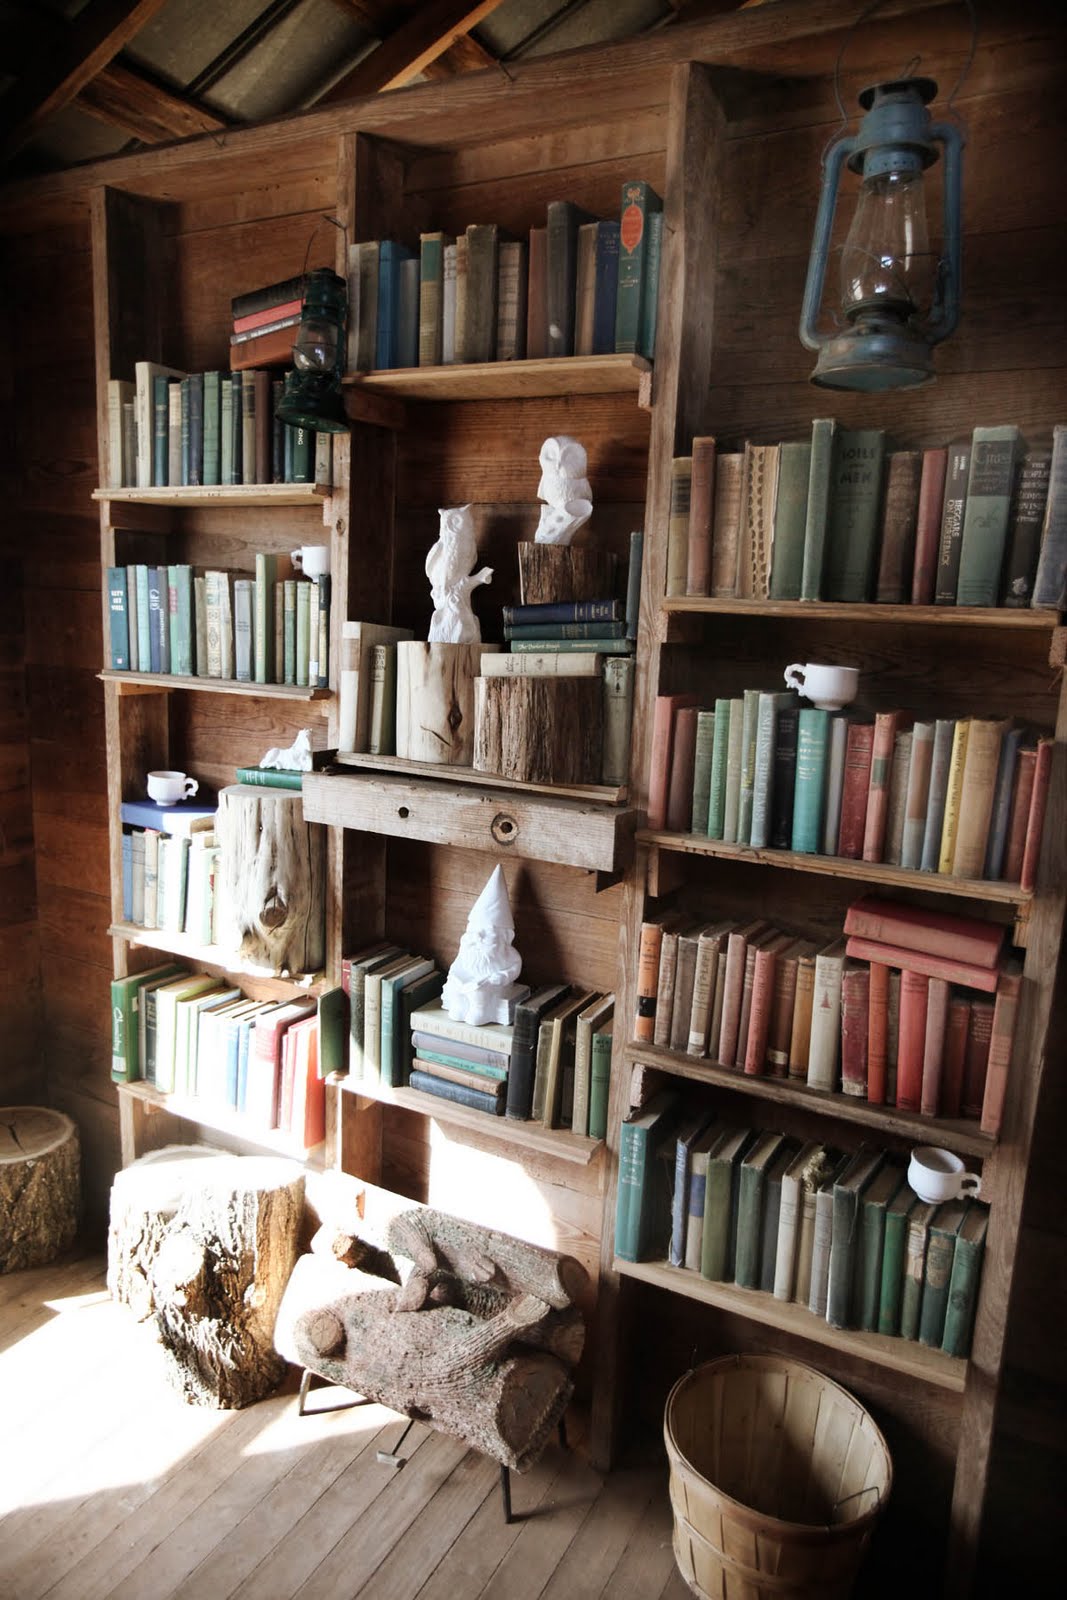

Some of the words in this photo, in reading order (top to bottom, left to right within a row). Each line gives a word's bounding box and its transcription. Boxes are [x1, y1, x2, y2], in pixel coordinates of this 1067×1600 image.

[946, 500, 955, 513] ON
[951, 499, 963, 537] BEGGARS
[941, 516, 953, 565] HORSEBACK
